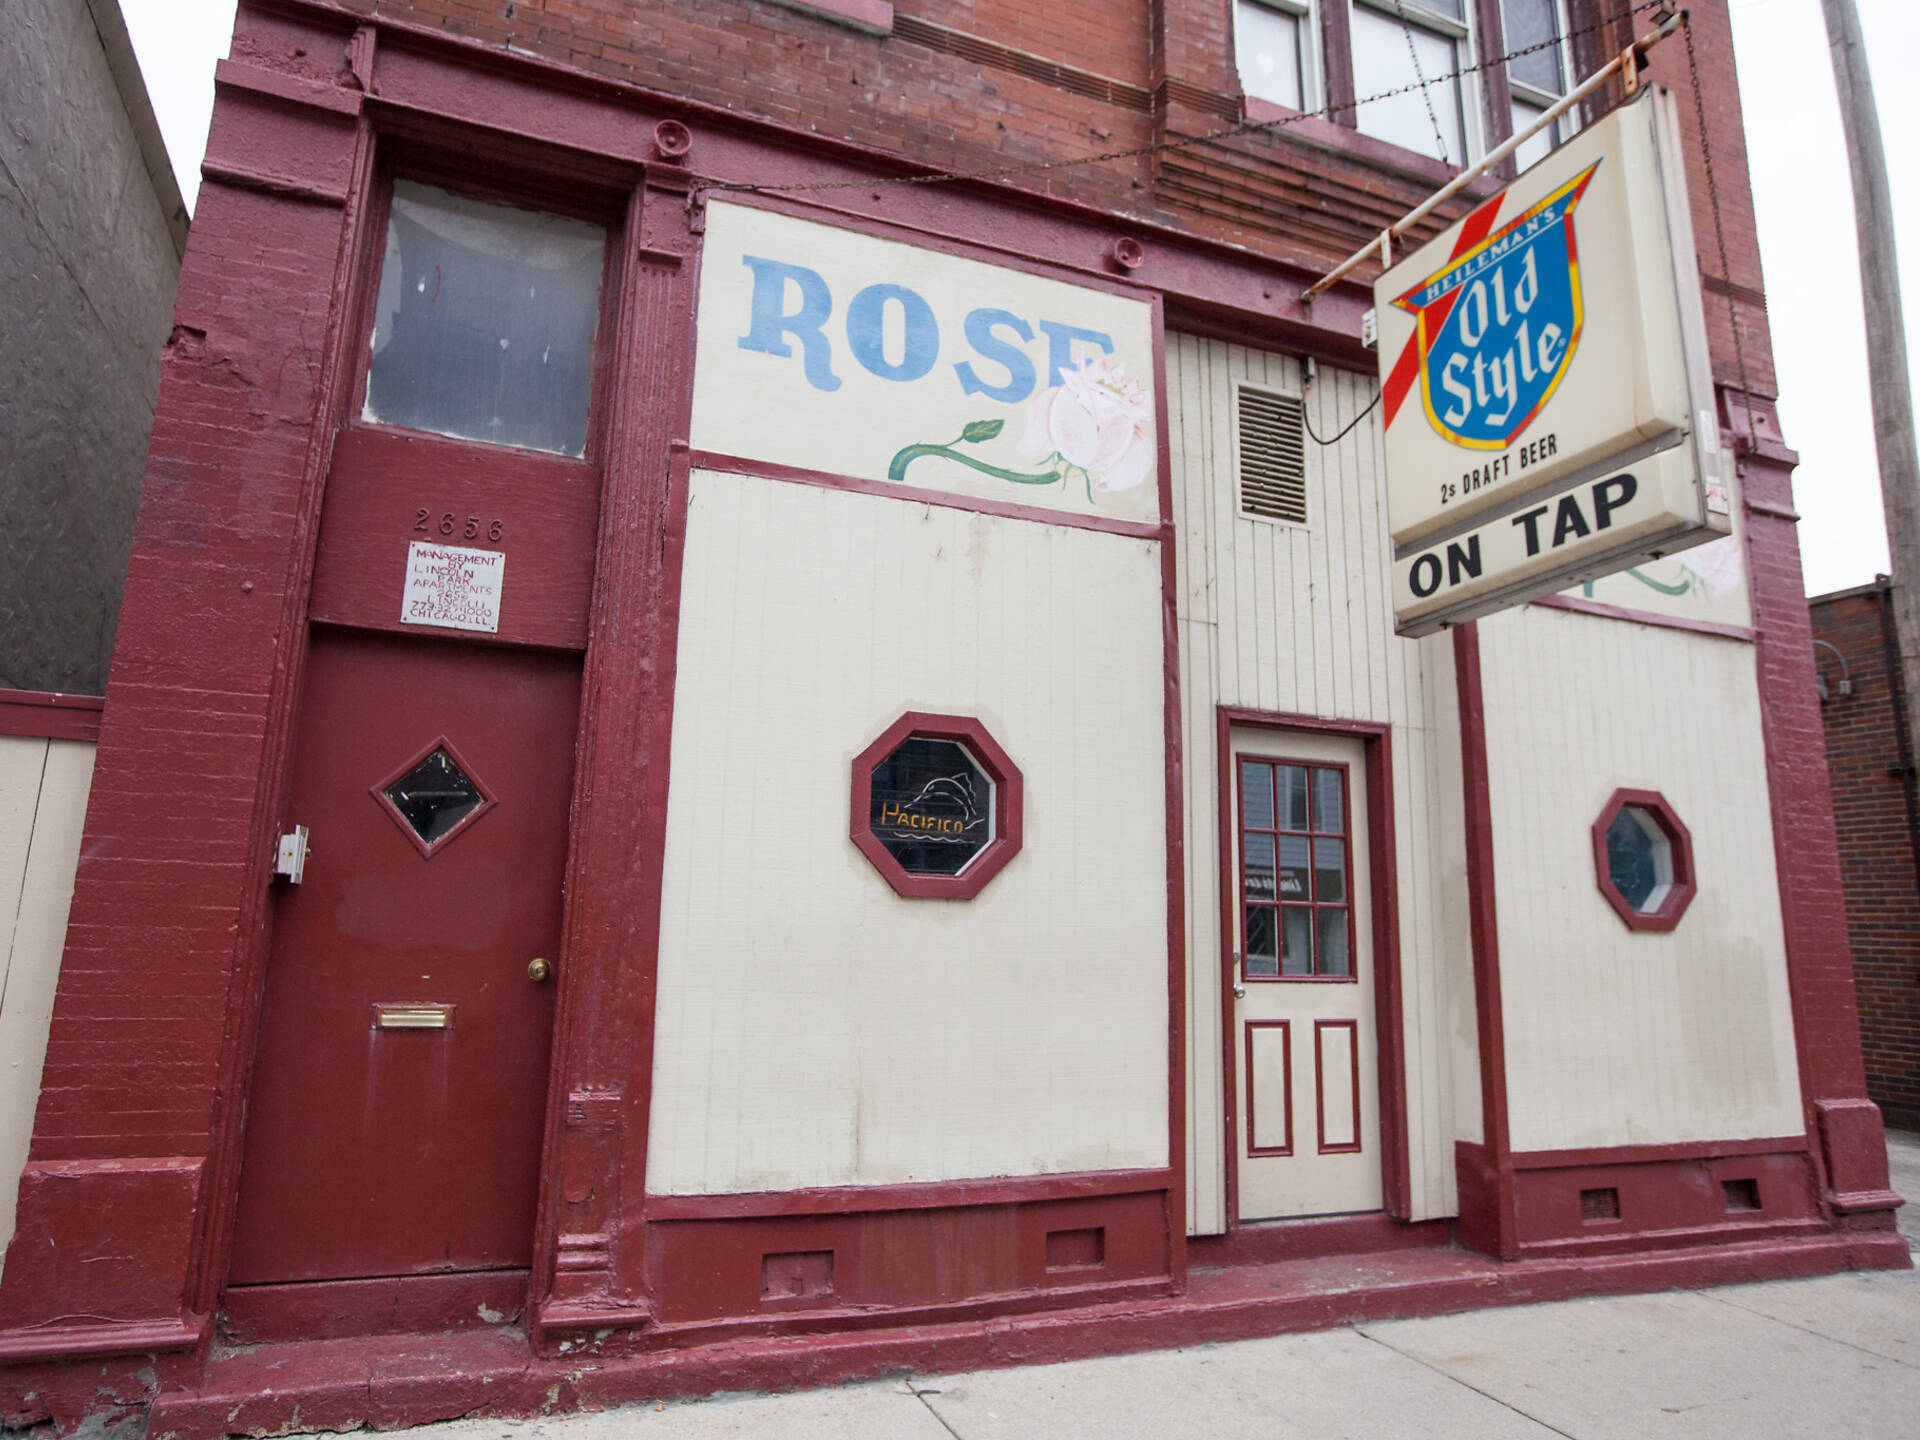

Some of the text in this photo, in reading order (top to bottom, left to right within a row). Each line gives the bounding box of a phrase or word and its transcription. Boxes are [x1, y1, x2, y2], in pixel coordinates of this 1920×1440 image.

[1425, 206, 1556, 302] HEILEMAN'S
[1459, 244, 1539, 348] Old
[1441, 318, 1563, 428] Style
[1463, 454, 1510, 495] DRAFT
[1520, 433, 1558, 469] BEER
[413, 507, 504, 542] 2656
[1409, 534, 1483, 598] ON
[1512, 473, 1638, 558] TAP
[414, 563, 475, 578] LINCOLN
[438, 575, 470, 586] PARK
